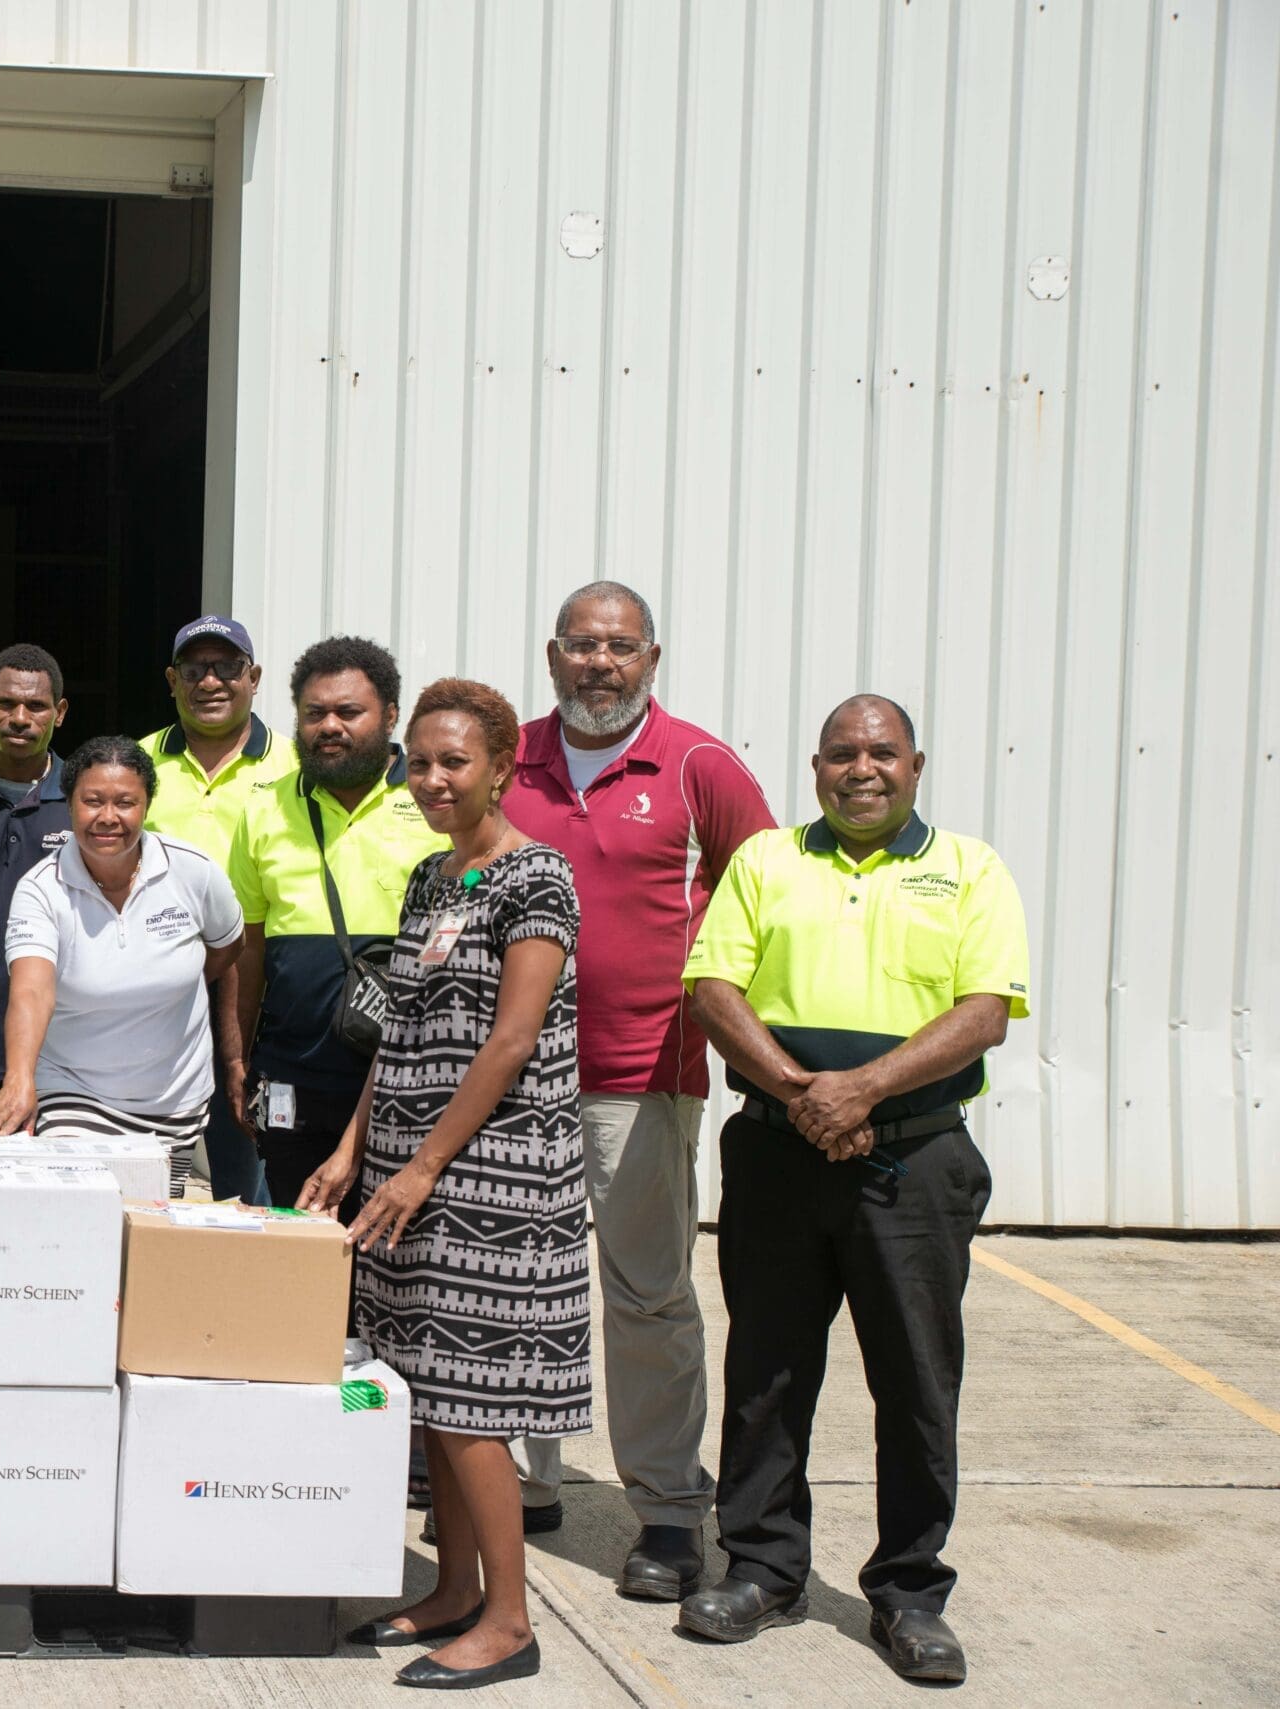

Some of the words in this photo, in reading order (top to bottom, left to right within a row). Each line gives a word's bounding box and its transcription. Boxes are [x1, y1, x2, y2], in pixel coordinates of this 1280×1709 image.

[930, 878, 959, 889] TRANS
[146, 917, 162, 925] EMO
[168, 911, 189, 920] TRANS
[203, 1481, 269, 1499] HENRY
